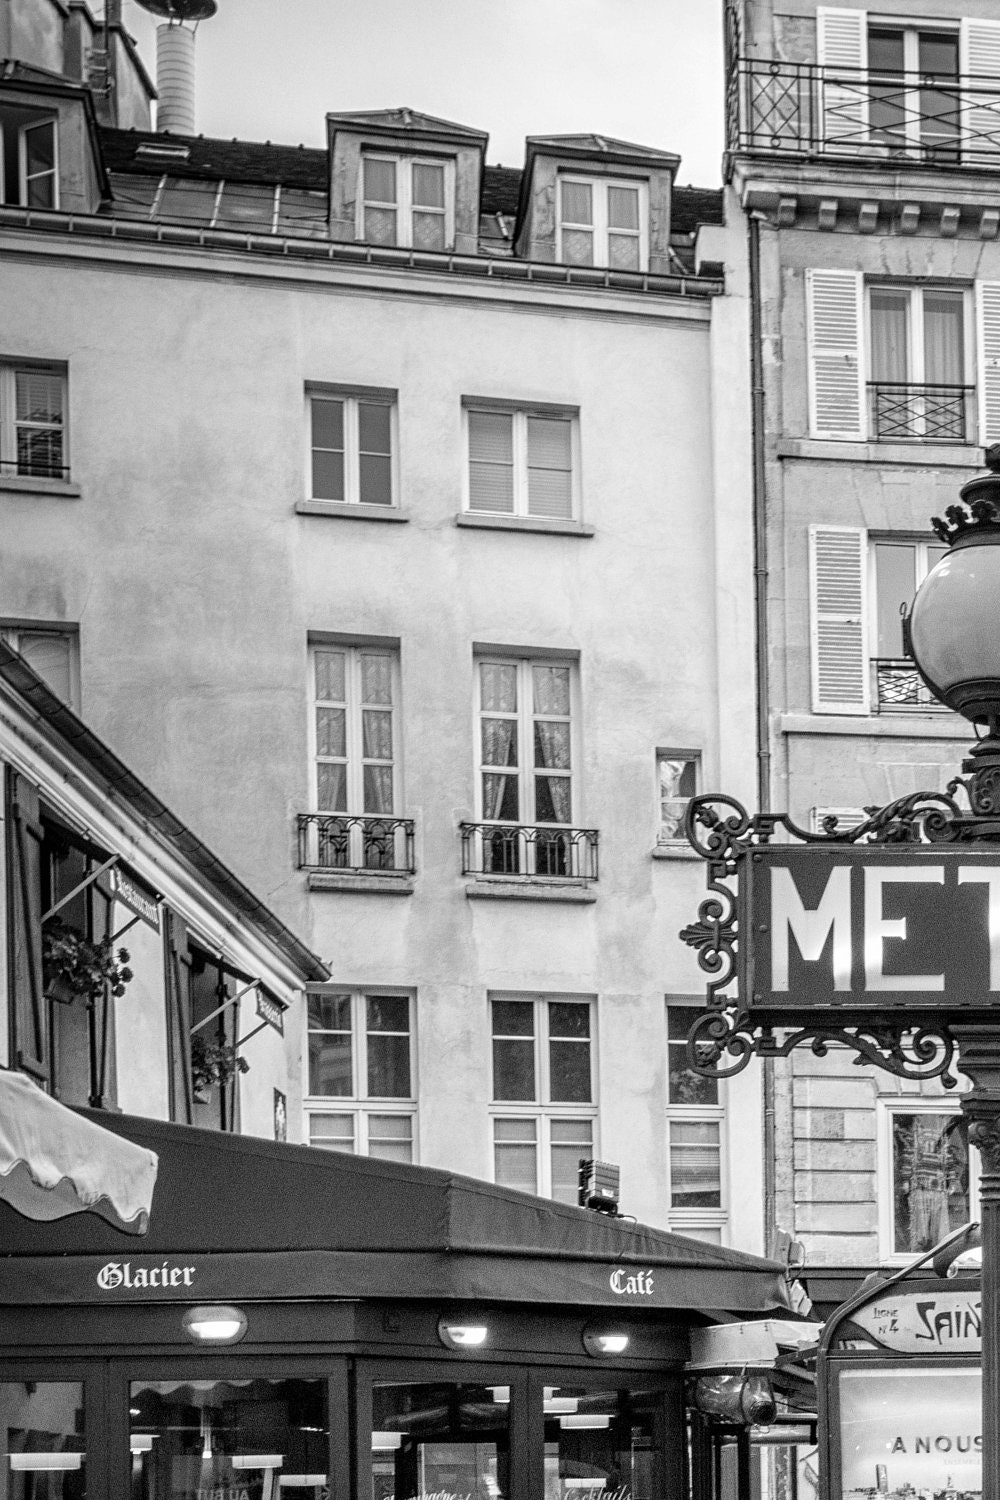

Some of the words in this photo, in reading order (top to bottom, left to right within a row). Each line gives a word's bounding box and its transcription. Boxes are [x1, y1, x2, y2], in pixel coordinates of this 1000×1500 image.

[97, 1261, 196, 1290] Glacier
[609, 1269, 655, 1295] Café
[892, 1437, 907, 1453] A
